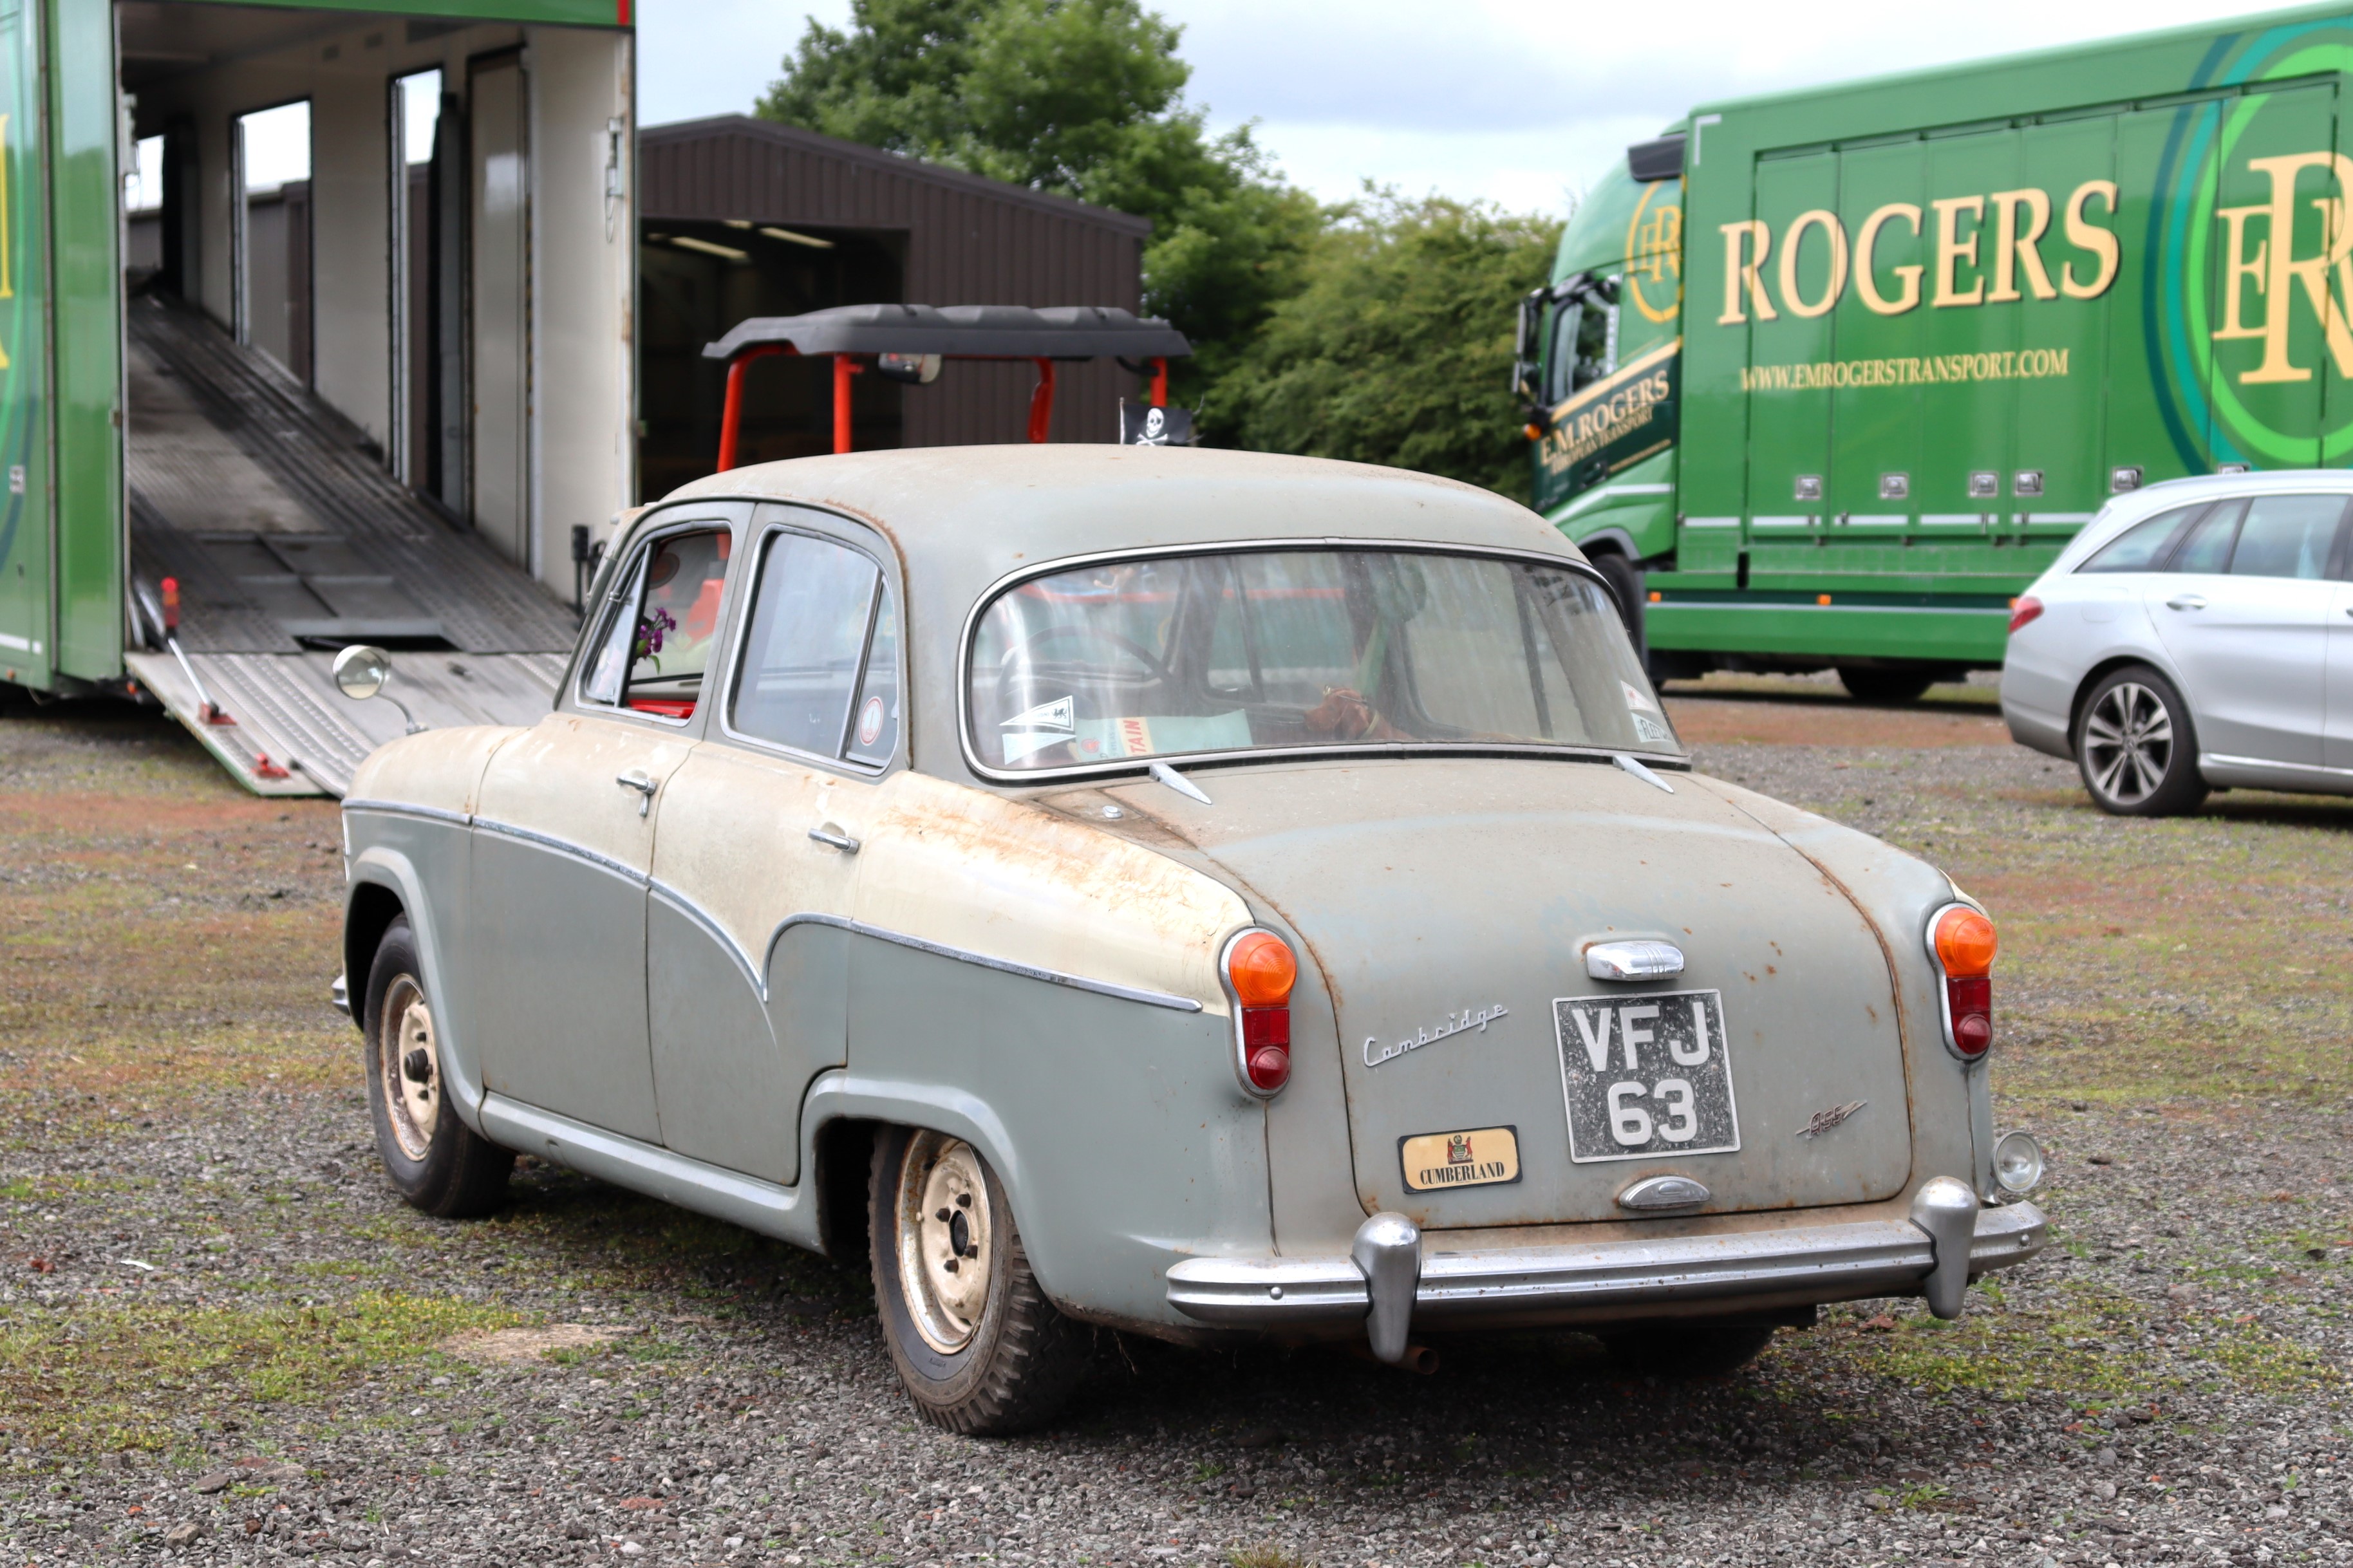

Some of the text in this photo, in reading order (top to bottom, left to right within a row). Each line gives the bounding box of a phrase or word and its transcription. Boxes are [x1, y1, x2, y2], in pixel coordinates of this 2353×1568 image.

[1717, 179, 2119, 326] ROGERS
[1740, 348, 2070, 391] WWW.EMROGERSTRANSPORT.COM
[1122, 719, 1147, 756] TAIN
[1363, 1003, 1508, 1067] Cambridge
[1572, 1002, 1710, 1072] VFJ
[1608, 1079, 1698, 1146] 63
[1810, 1105, 1842, 1136] A55
[1420, 1161, 1505, 1185] CUMBERLAND
